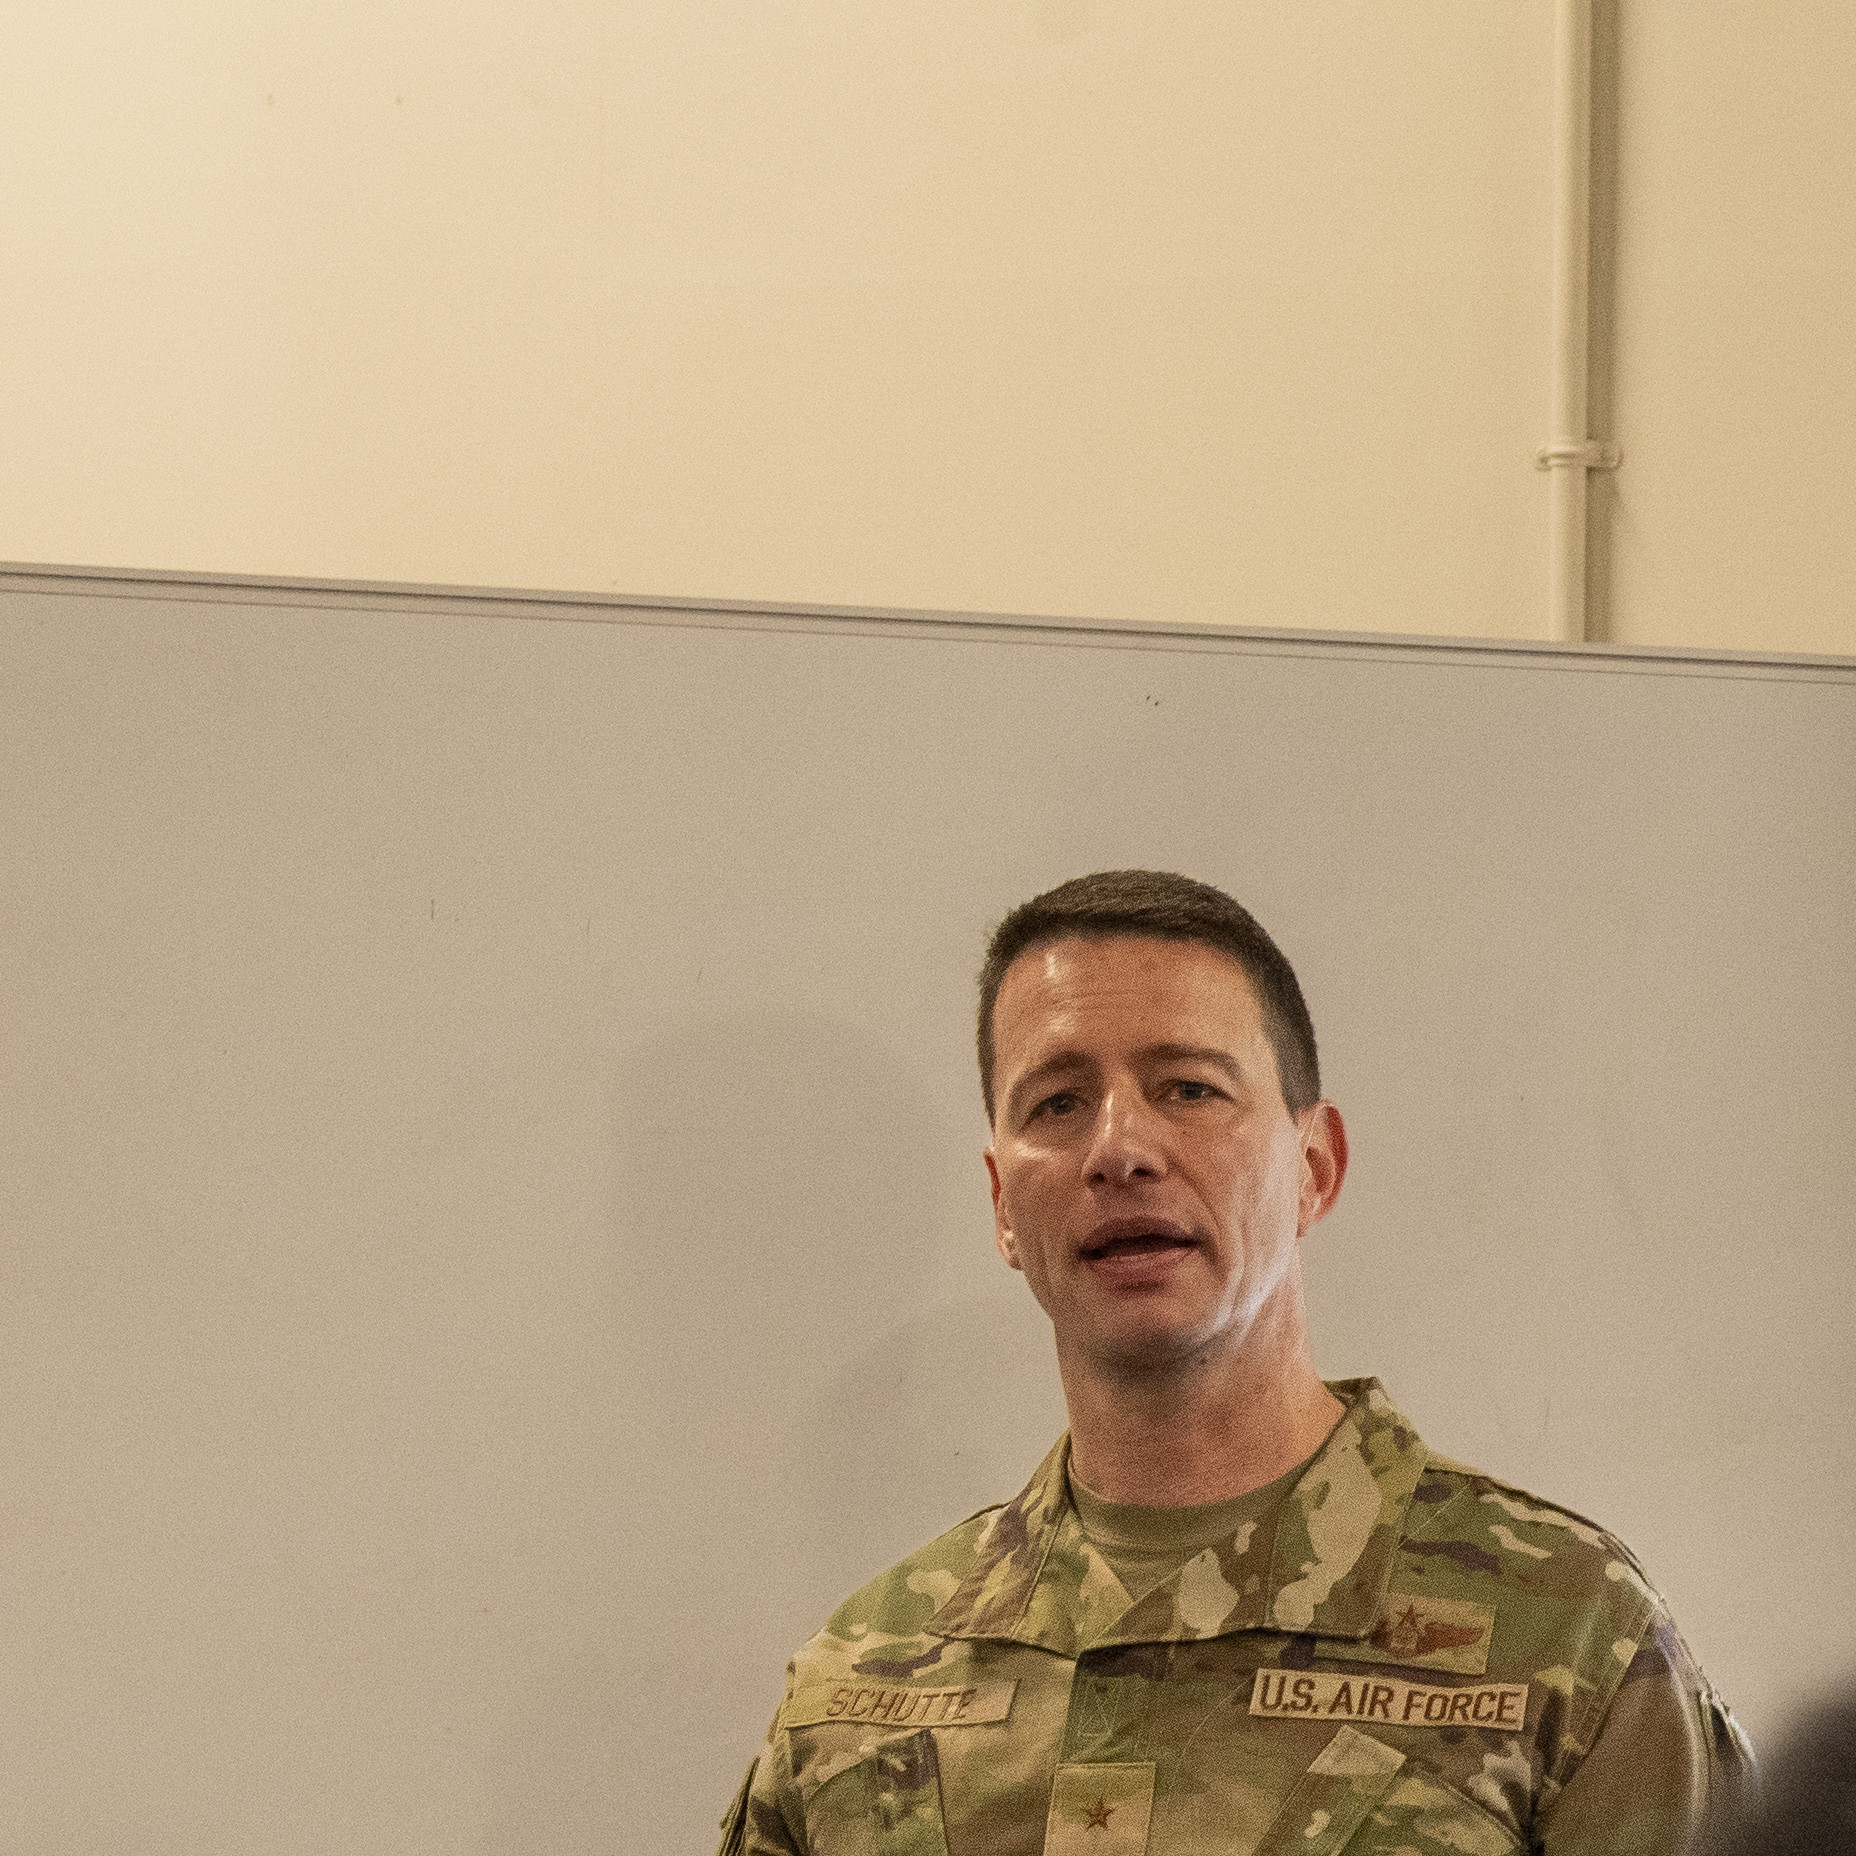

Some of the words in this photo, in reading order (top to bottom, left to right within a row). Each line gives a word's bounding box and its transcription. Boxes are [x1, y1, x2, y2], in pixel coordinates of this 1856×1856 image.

[825, 1687, 977, 1722] SCHUTTE
[1258, 1673, 1320, 1714] U.S.
[1327, 1680, 1395, 1720] AIR
[1401, 1688, 1522, 1724] FORCE
